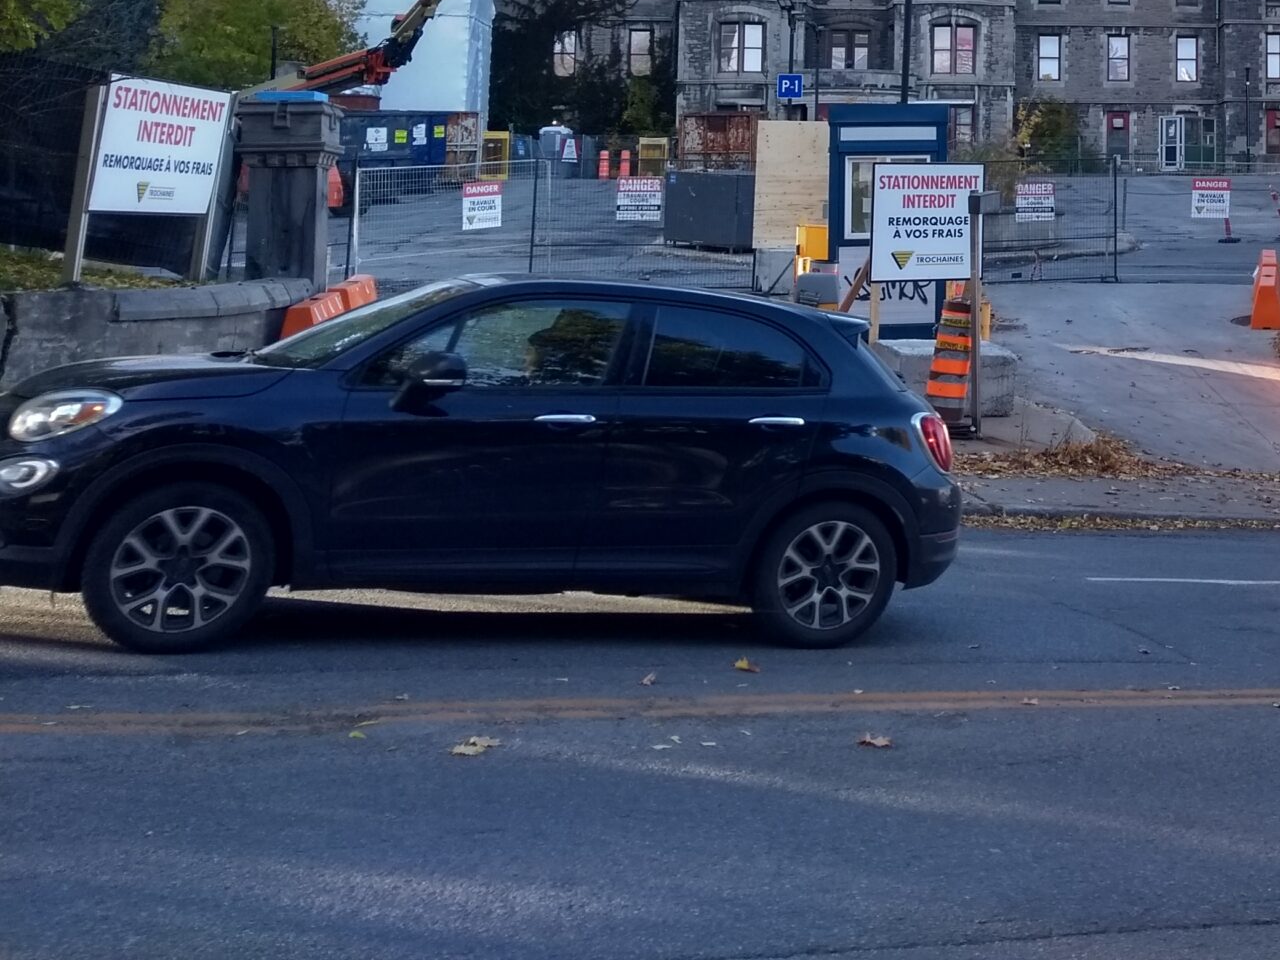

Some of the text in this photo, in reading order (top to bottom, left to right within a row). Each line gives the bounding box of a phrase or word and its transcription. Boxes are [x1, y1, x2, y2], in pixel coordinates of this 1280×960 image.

[782, 80, 799, 93] P-1
[113, 85, 225, 122] STATIONNEMENT
[137, 120, 196, 147] INTERDIT
[102, 154, 213, 176] REMORQUAGE À VOS FRAIS
[466, 184, 499, 194] DANGER
[619, 179, 661, 191] DANGER
[879, 175, 979, 190] STATIONNEMENT
[1017, 183, 1053, 194] DANGER
[902, 194, 956, 208] INTERDIT
[888, 216, 969, 226] REMORQUAGE
[893, 227, 963, 238] À VOS FRAIS
